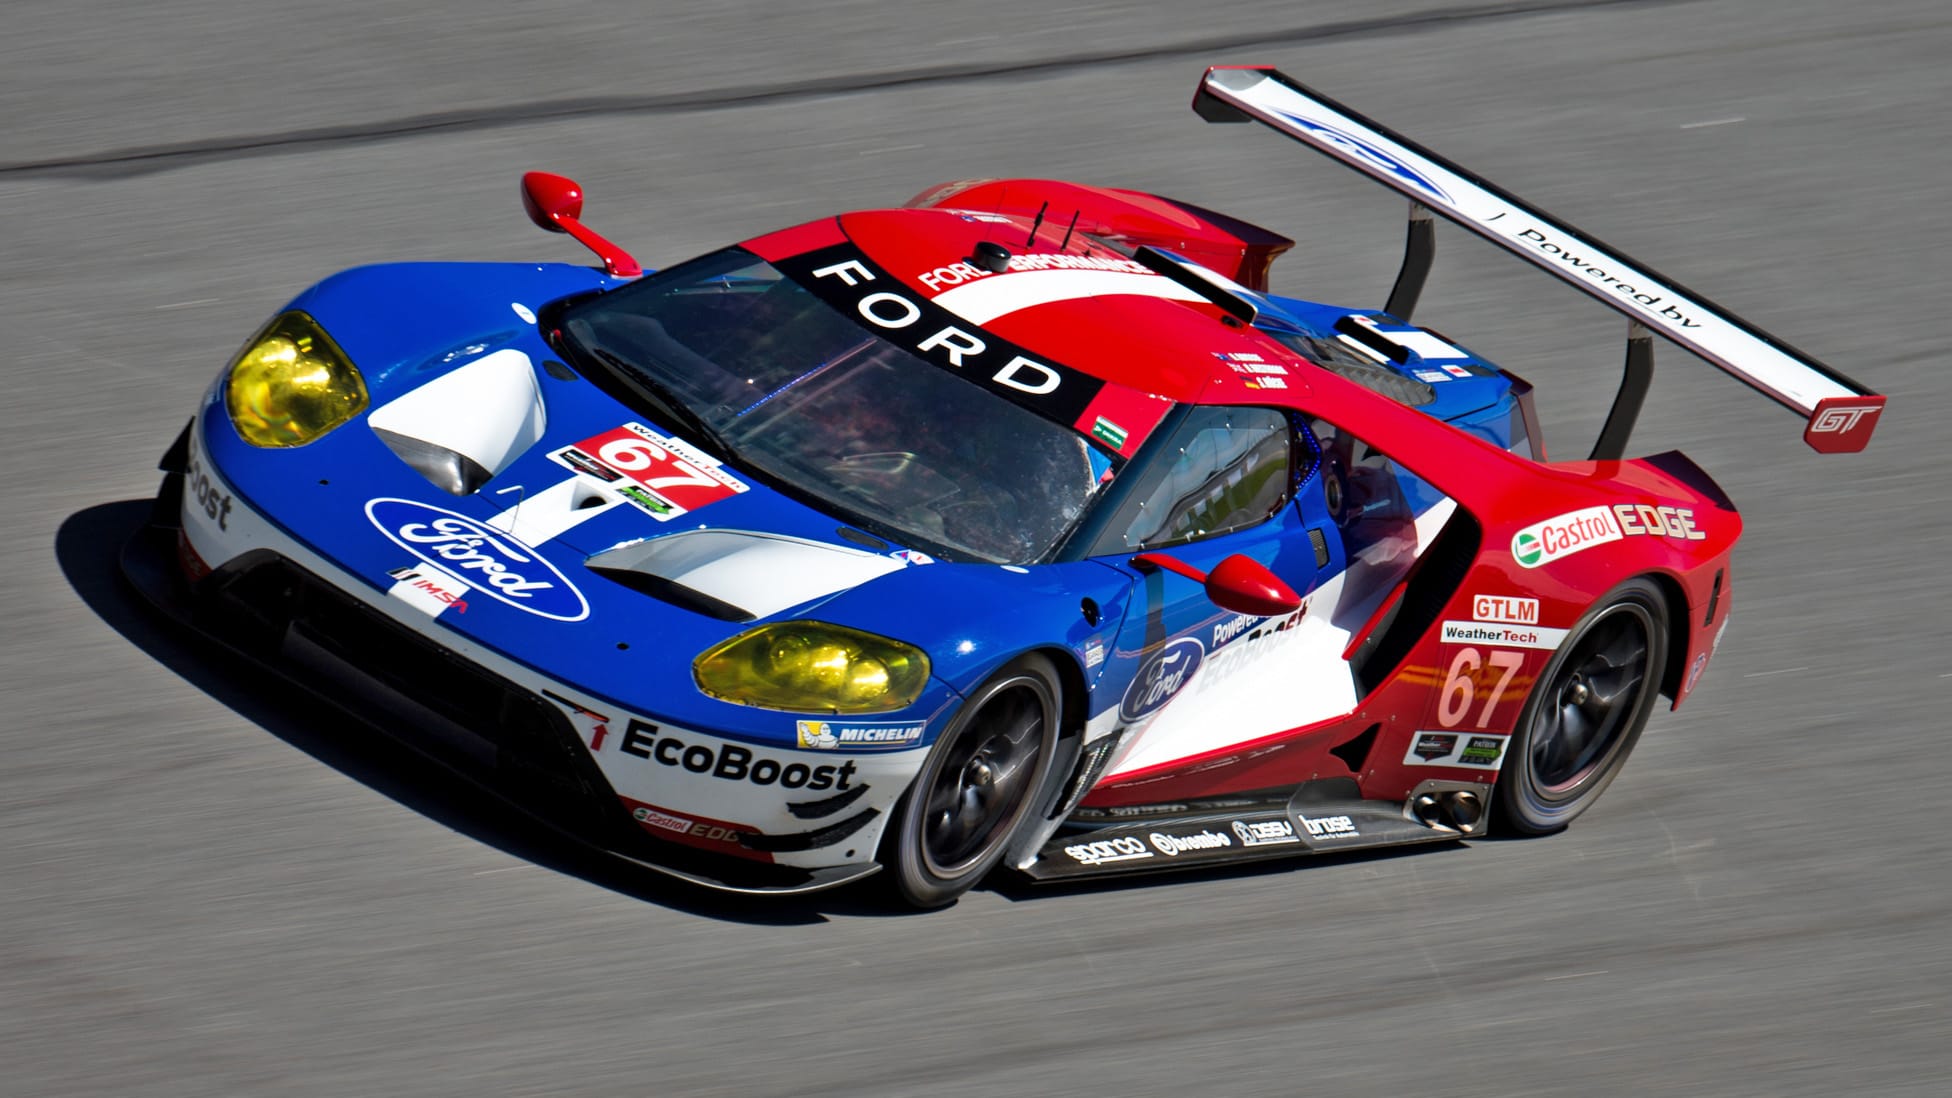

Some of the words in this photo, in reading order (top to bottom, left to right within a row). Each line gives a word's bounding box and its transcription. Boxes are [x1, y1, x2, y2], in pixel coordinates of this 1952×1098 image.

[918, 262, 992, 291] FOR
[1518, 228, 1661, 305] Powered
[812, 260, 1061, 394] FORD
[1811, 406, 1882, 434] GT
[598, 438, 721, 489] 67
[633, 425, 742, 489] WeatherTech
[1541, 511, 1616, 555] Castrol
[1613, 503, 1706, 540] EDGE
[399, 518, 553, 597] Ford
[412, 580, 468, 614] IMSA
[1476, 599, 1535, 622] GTLM
[1446, 627, 1538, 643] WeatherTech
[1132, 650, 1191, 713] Ford
[1438, 648, 1525, 729] 67
[839, 727, 924, 741] MICHELIN
[620, 718, 856, 790] EcoBoost
[646, 813, 688, 831] Castrol
[689, 823, 738, 842] EDG
[1166, 830, 1231, 851] brembo
[1298, 814, 1355, 835] brose
[1064, 836, 1147, 865] sparco
